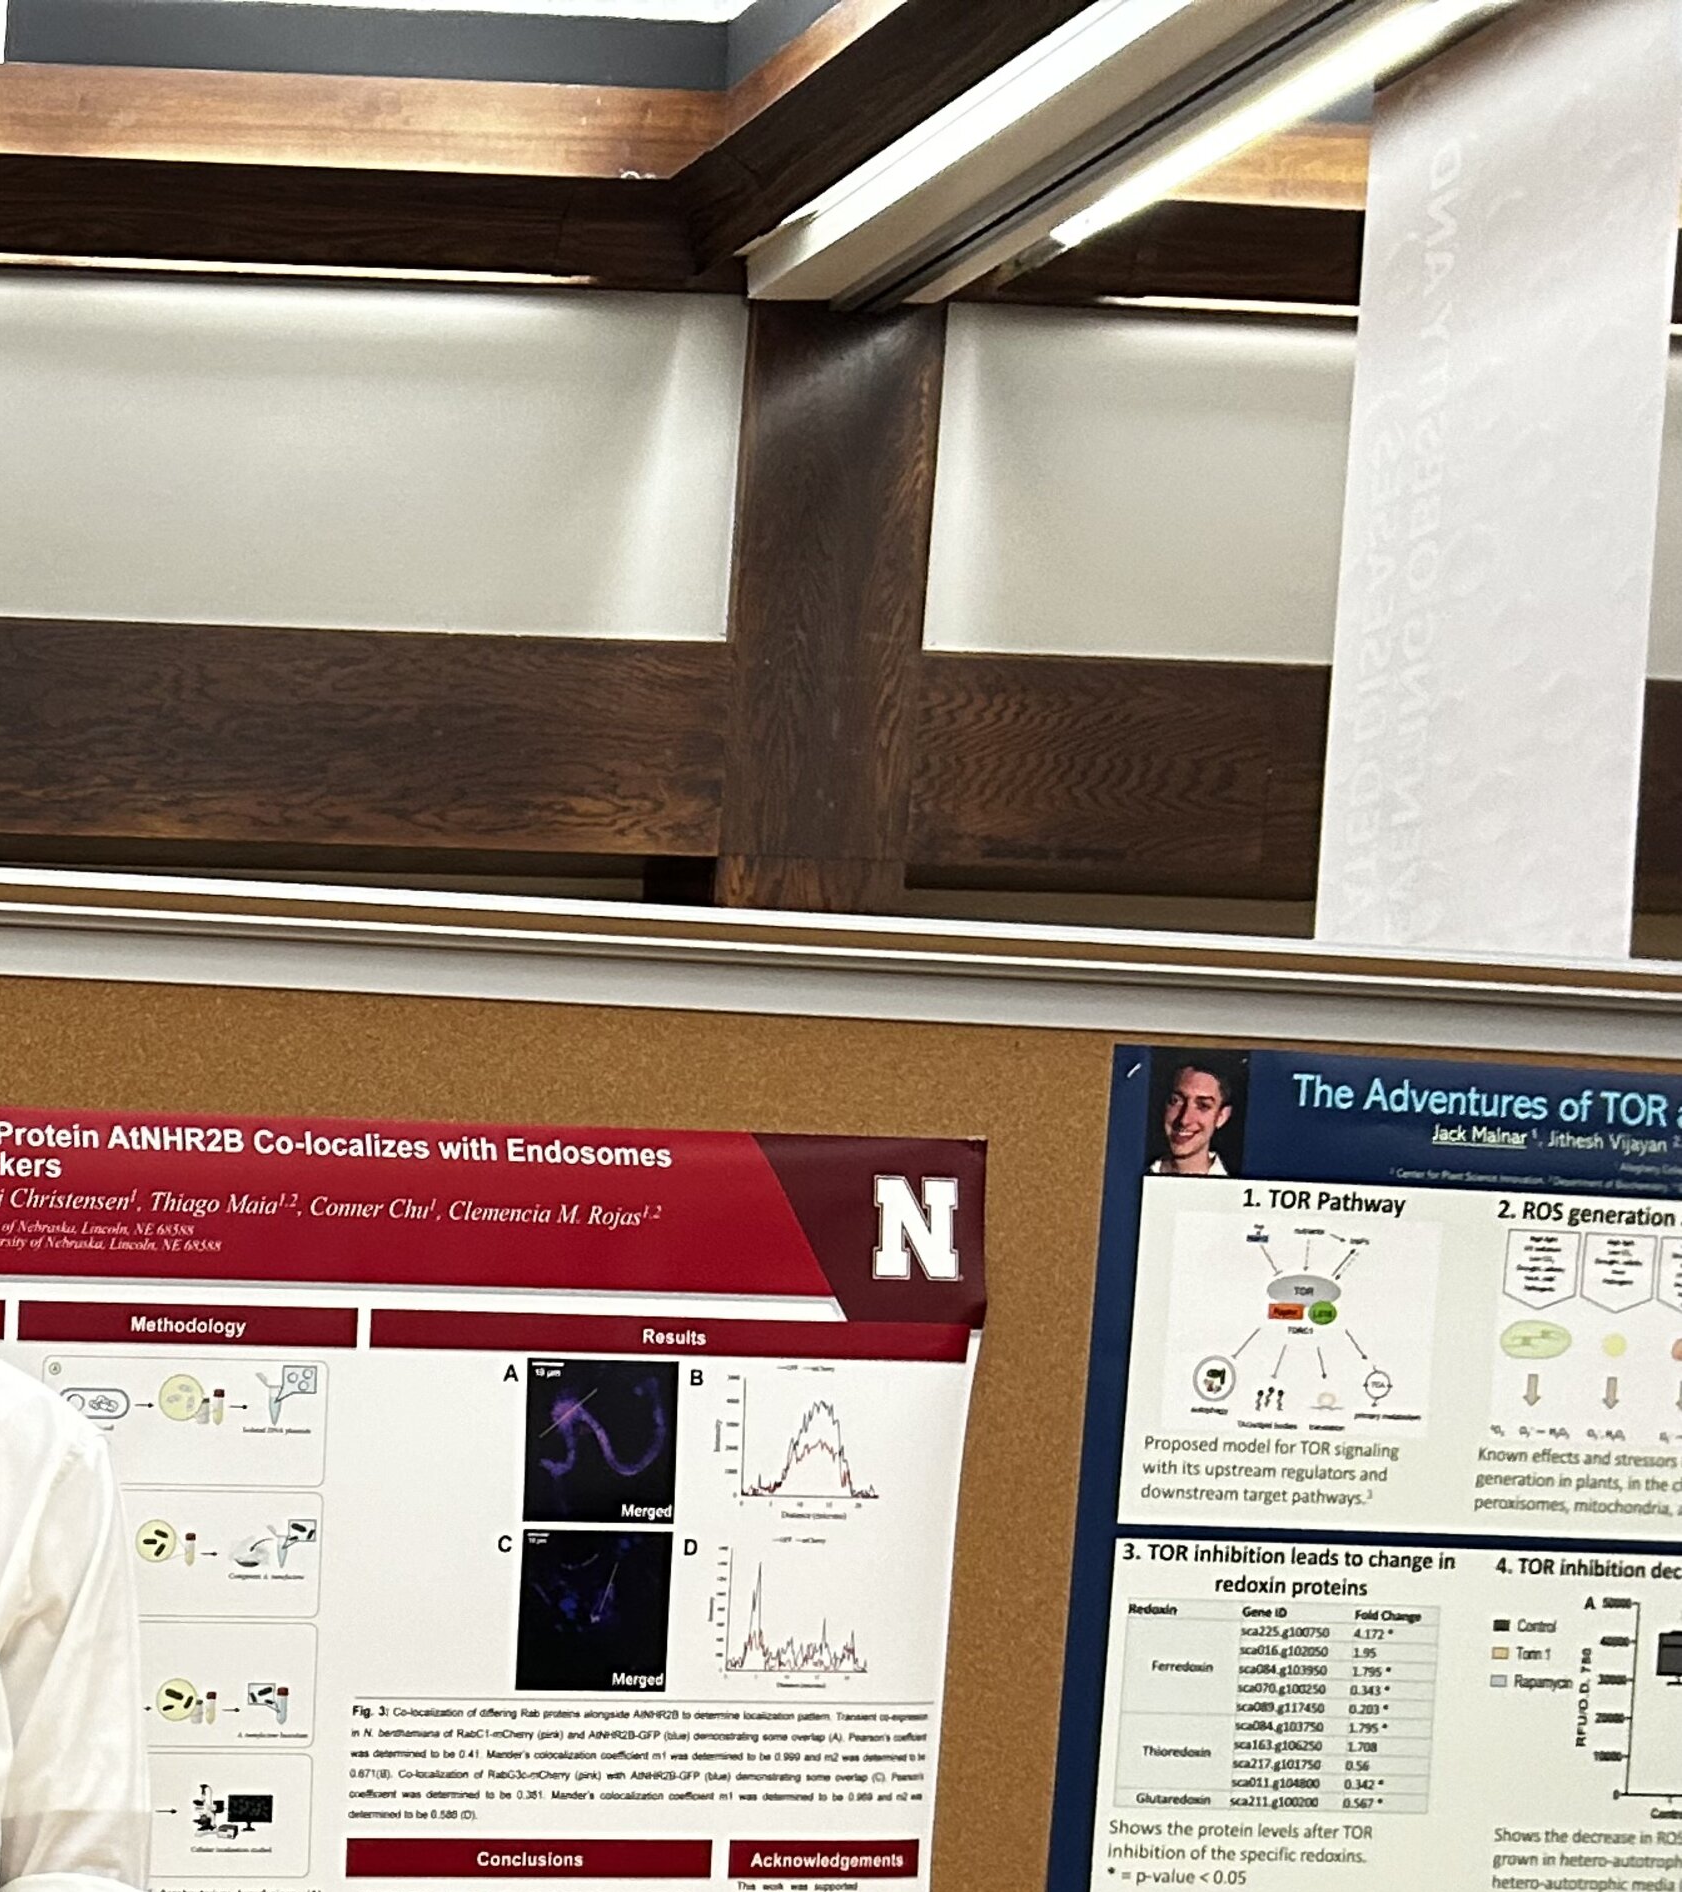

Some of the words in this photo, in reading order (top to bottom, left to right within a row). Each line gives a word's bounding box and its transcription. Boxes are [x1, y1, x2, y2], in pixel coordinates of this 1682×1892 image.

[1293, 1073, 1353, 1109] The
[1362, 1077, 1547, 1119] Adventures
[1559, 1090, 1592, 1121] of
[1599, 1091, 1668, 1126] TOR
[1432, 1124, 1466, 1142] Jack
[107, 1126, 244, 1152] AtNHR2B
[253, 1131, 429, 1158] Co-localizes
[438, 1137, 497, 1160] with
[506, 1138, 671, 1167] Endosomes
[151, 1191, 219, 1216] Thiago
[310, 1196, 383, 1217] Conner
[449, 1200, 551, 1222] Clemencia
[557, 1204, 578, 1223] M.
[1243, 1188, 1260, 1206] 1.
[1268, 1189, 1310, 1209] TOR
[1317, 1191, 1405, 1218] Pathway
[1497, 1199, 1515, 1218] 2.
[1522, 1201, 1562, 1221] ROS
[1567, 1205, 1675, 1229] generation
[873, 1175, 959, 1281] N
[131, 1316, 245, 1337] Methodology
[642, 1328, 706, 1345] Results
[503, 1364, 518, 1381] A
[690, 1369, 703, 1385] B
[1144, 1435, 1218, 1453] Proposed
[1223, 1438, 1270, 1453] model
[1274, 1438, 1296, 1454] for
[1300, 1440, 1330, 1455] TOR
[1334, 1443, 1399, 1461] signaling
[621, 1503, 672, 1522] Merged
[498, 1534, 512, 1552] C
[684, 1538, 697, 1555] D
[1122, 1542, 1140, 1559] 3.
[1147, 1543, 1188, 1561] TOR
[1193, 1544, 1284, 1564] inhibition
[1291, 1546, 1338, 1565] leads
[1344, 1551, 1362, 1566] to
[1368, 1550, 1432, 1572] change
[1439, 1556, 1455, 1569] in
[1215, 1574, 1285, 1593] redoxin
[1291, 1578, 1367, 1598] proteins
[612, 1671, 664, 1690] Merged
[476, 1851, 582, 1866] Conclusions
[750, 1852, 903, 1870] Acknowledgements
